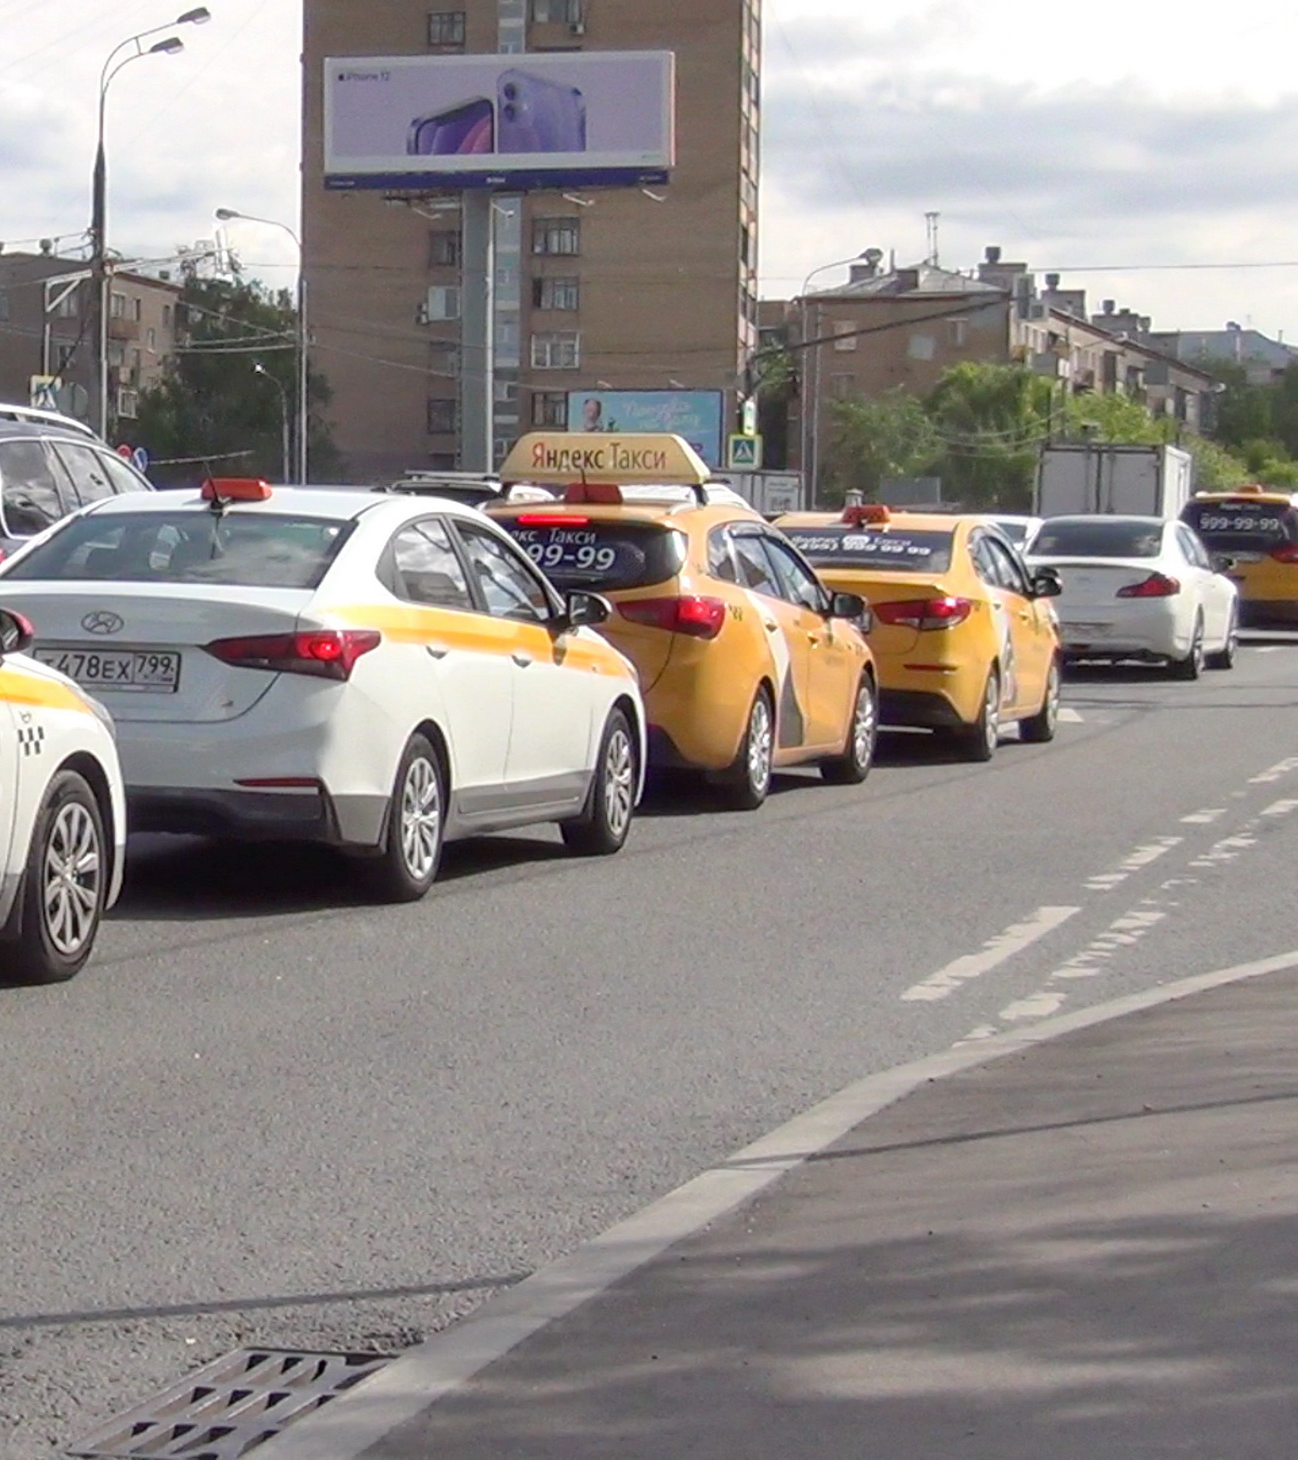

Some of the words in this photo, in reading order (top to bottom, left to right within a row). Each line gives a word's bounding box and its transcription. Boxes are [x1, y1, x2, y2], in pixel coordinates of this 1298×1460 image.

[531, 441, 605, 472] Яндекс
[610, 442, 667, 471] Такси
[548, 527, 597, 545] Такси
[137, 655, 172, 675] 799
